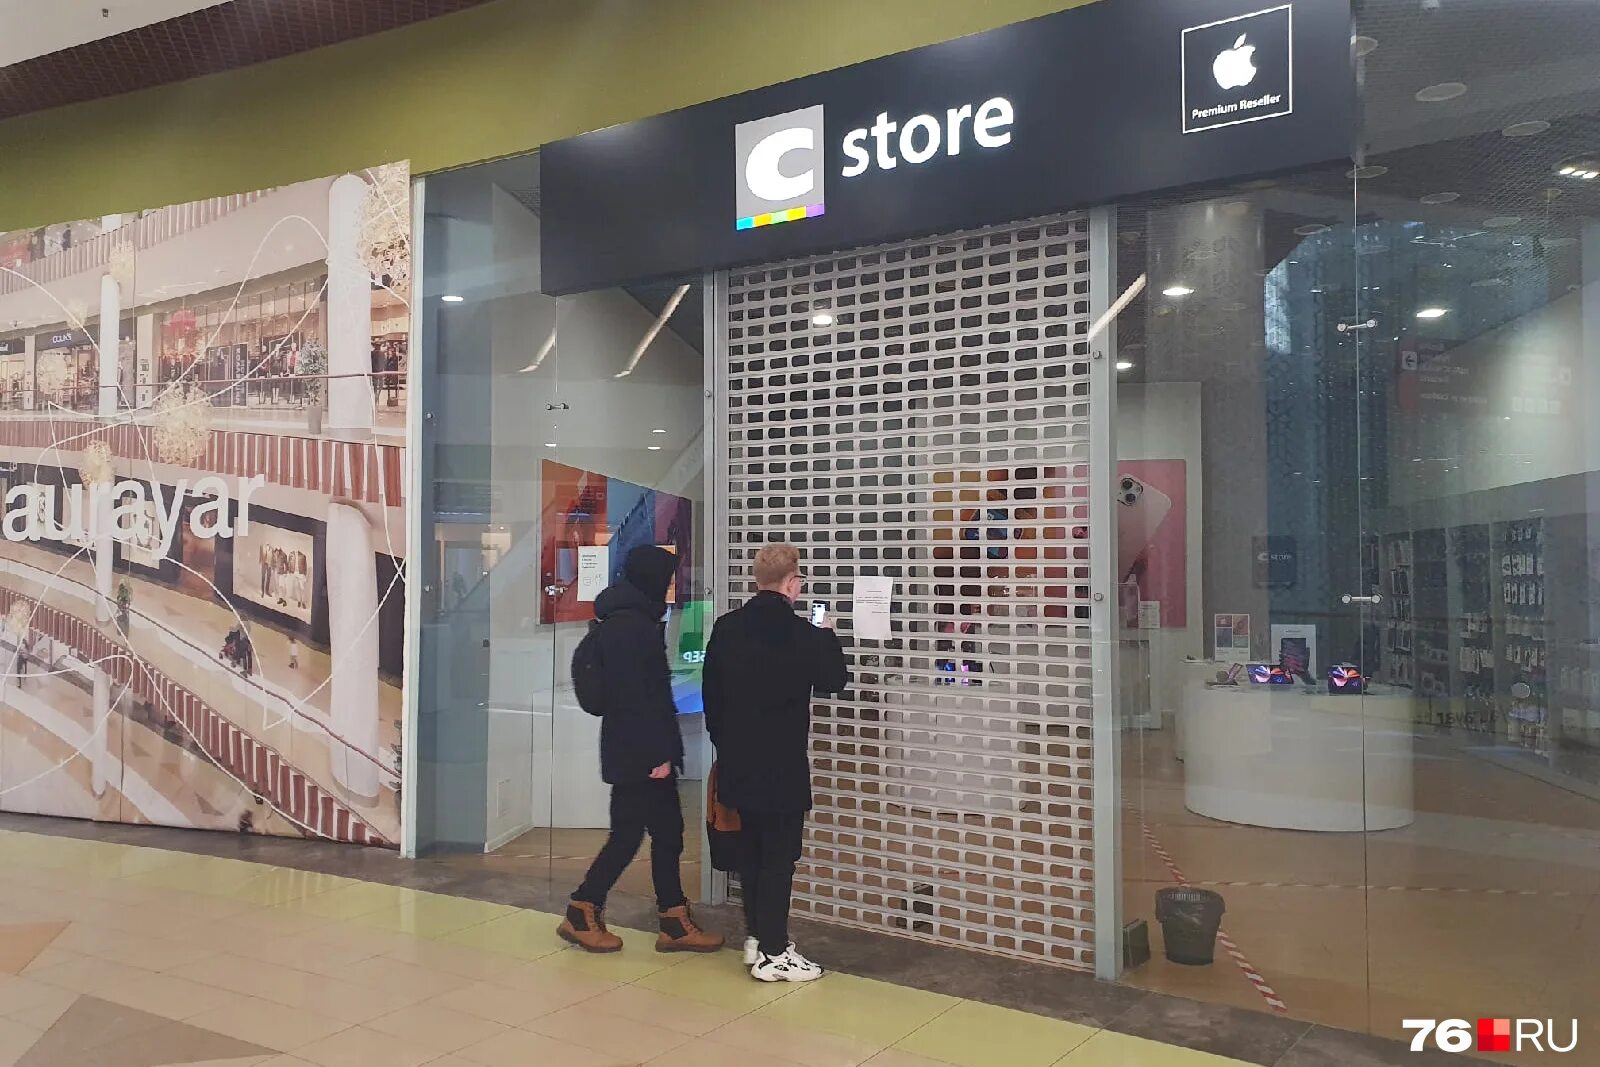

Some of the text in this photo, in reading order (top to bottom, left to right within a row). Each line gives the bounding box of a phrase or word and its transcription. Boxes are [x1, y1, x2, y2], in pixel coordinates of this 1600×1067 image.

[841, 97, 1014, 178] store
[1191, 94, 1281, 119] Premium Reseller
[2, 473, 265, 560] aurayar
